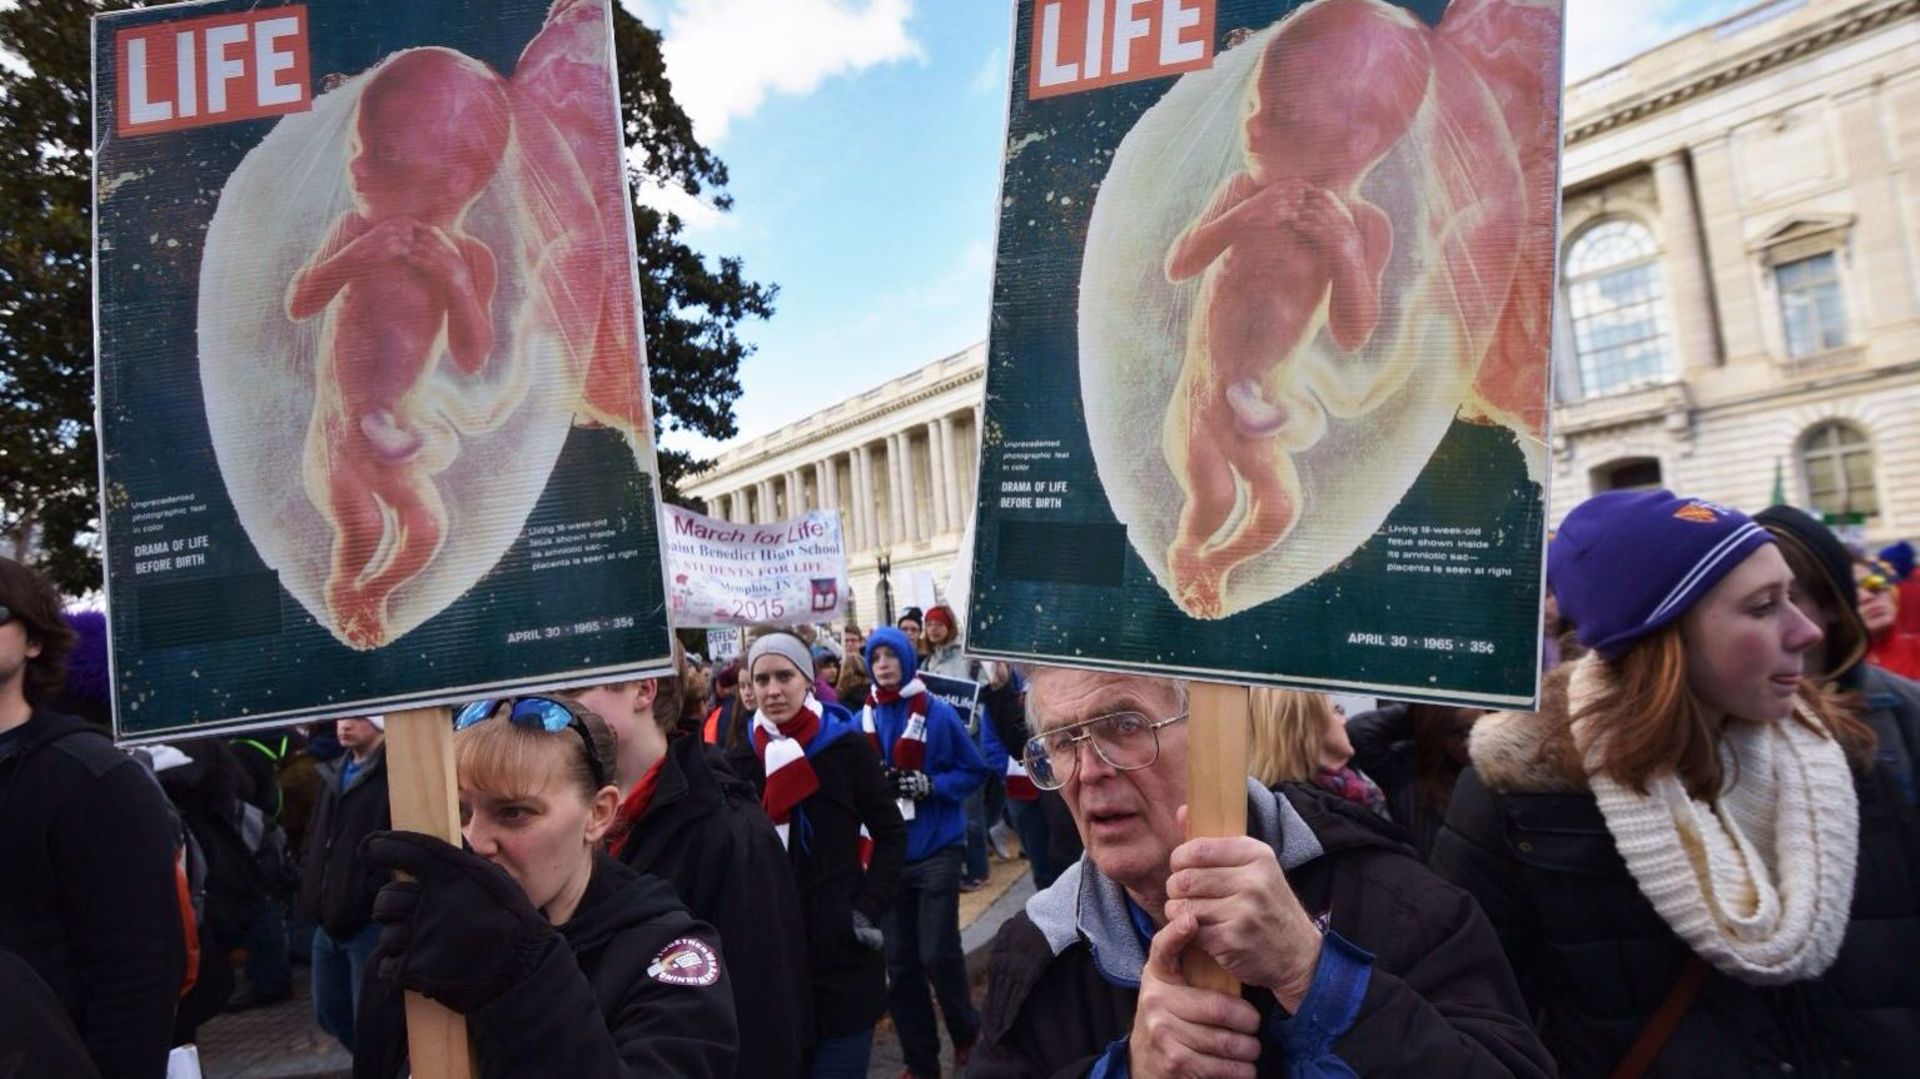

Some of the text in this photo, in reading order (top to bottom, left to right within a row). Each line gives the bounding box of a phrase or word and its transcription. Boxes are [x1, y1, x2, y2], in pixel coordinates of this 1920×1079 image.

[1039, 0, 1204, 87] LIFE
[128, 16, 302, 125] LIFE
[1004, 440, 1061, 449] Unprecedented
[1003, 452, 1052, 461] photographic
[1001, 481, 1068, 493] DRAMA OF LIFE
[1000, 497, 1062, 509] BEFORE BIRTH
[674, 515, 746, 543] March
[753, 530, 785, 545] for
[1389, 524, 1418, 534] Living
[134, 535, 209, 557] DRAMA OF LIFE
[667, 540, 840, 561] aint Benedict High School
[1388, 537, 1489, 549] fetus shown inside
[1402, 551, 1447, 560] amniotic
[135, 553, 205, 574] BEFORE BIRTH
[683, 560, 822, 577] STUDENTS FOR LIFE
[1387, 563, 1431, 572] placenta
[1446, 566, 1471, 574] seen
[1487, 567, 1512, 577] right
[732, 598, 784, 619] 2015
[507, 629, 542, 643] APRIL
[545, 626, 561, 638] 30
[573, 620, 600, 634] 1965
[709, 630, 738, 643] DEFEND
[716, 642, 732, 655] LIFE
[1347, 632, 1495, 654] APRIL 30 1965 35¢
